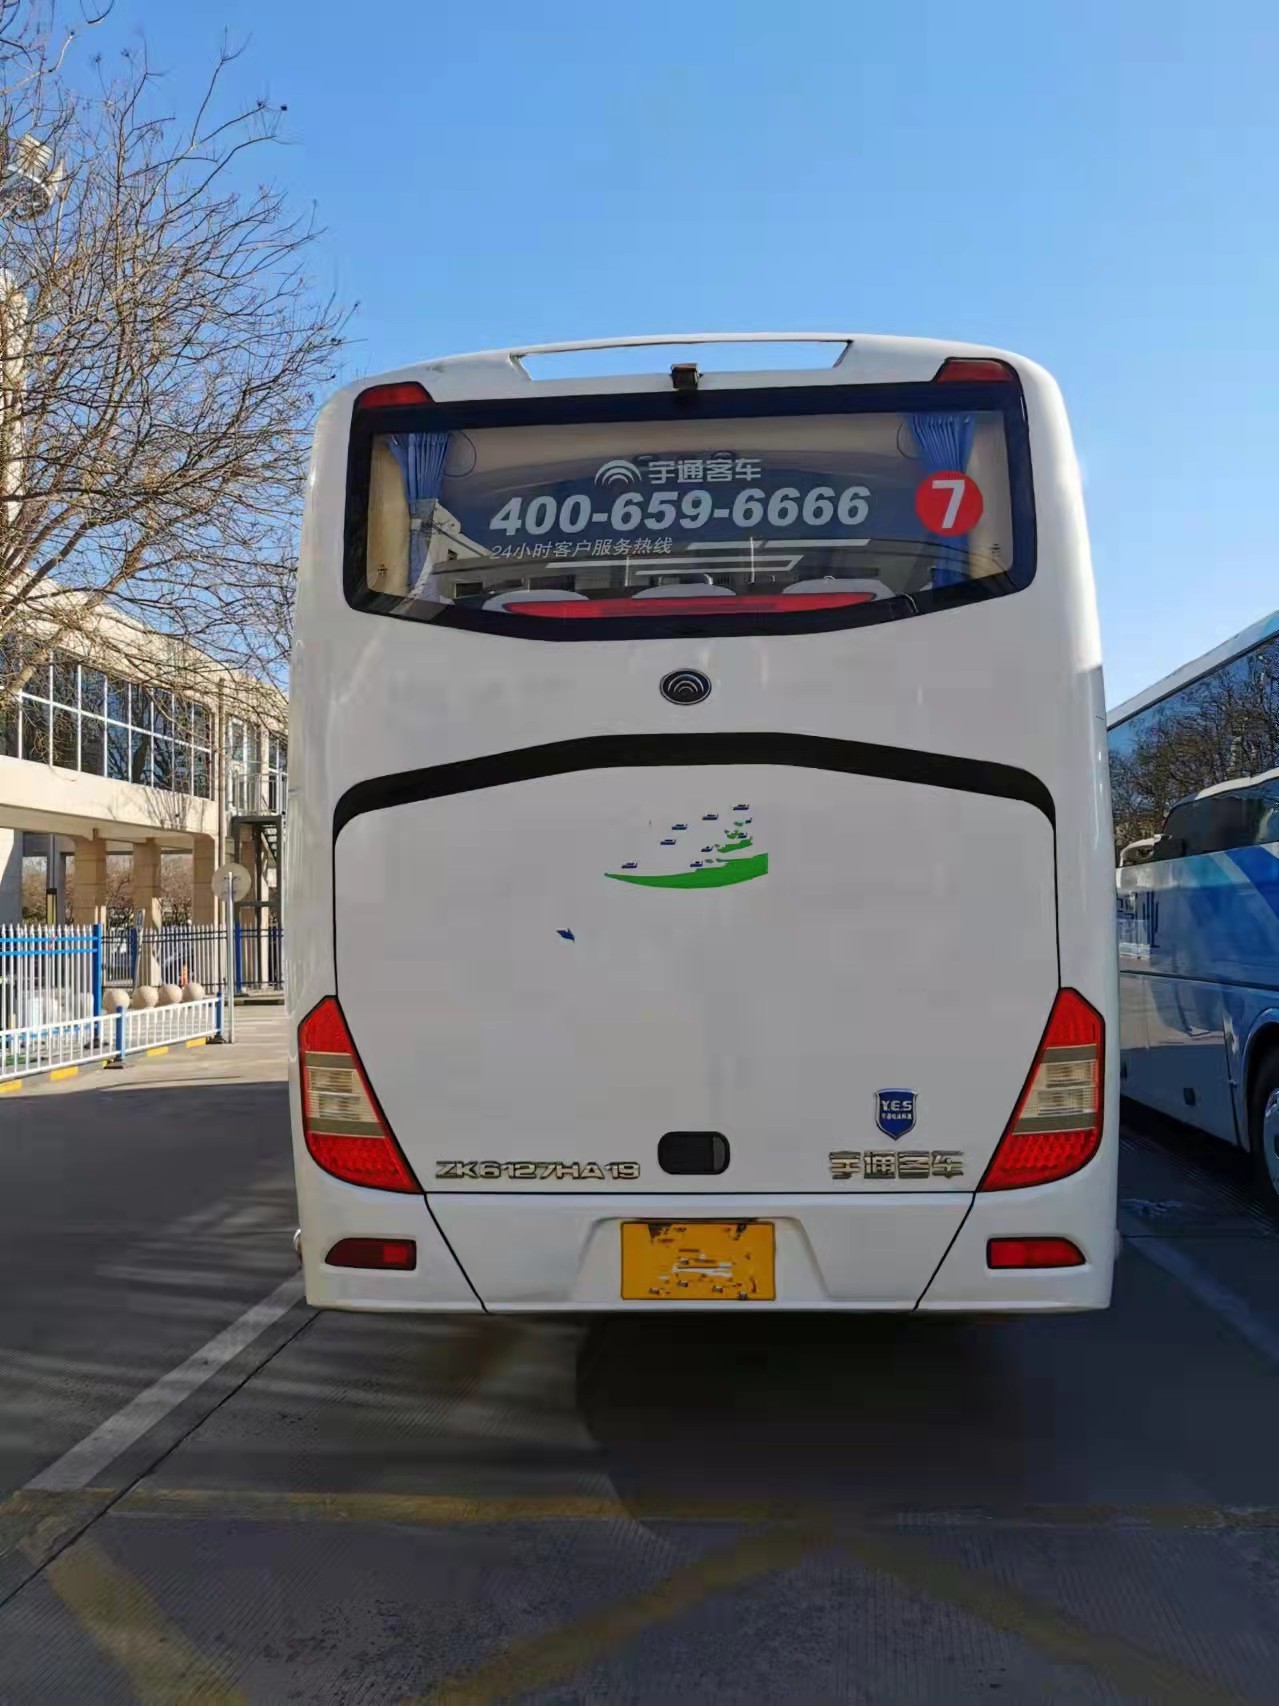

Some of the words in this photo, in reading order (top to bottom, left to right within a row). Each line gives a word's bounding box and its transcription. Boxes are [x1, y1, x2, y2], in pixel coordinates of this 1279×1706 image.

[647, 458, 762, 484] 宇通客车
[489, 486, 871, 535] 400-659-6666
[931, 479, 965, 529] 7
[489, 536, 673, 560] 24小时客户服务热线
[435, 1161, 641, 1180] ZK6127HA19
